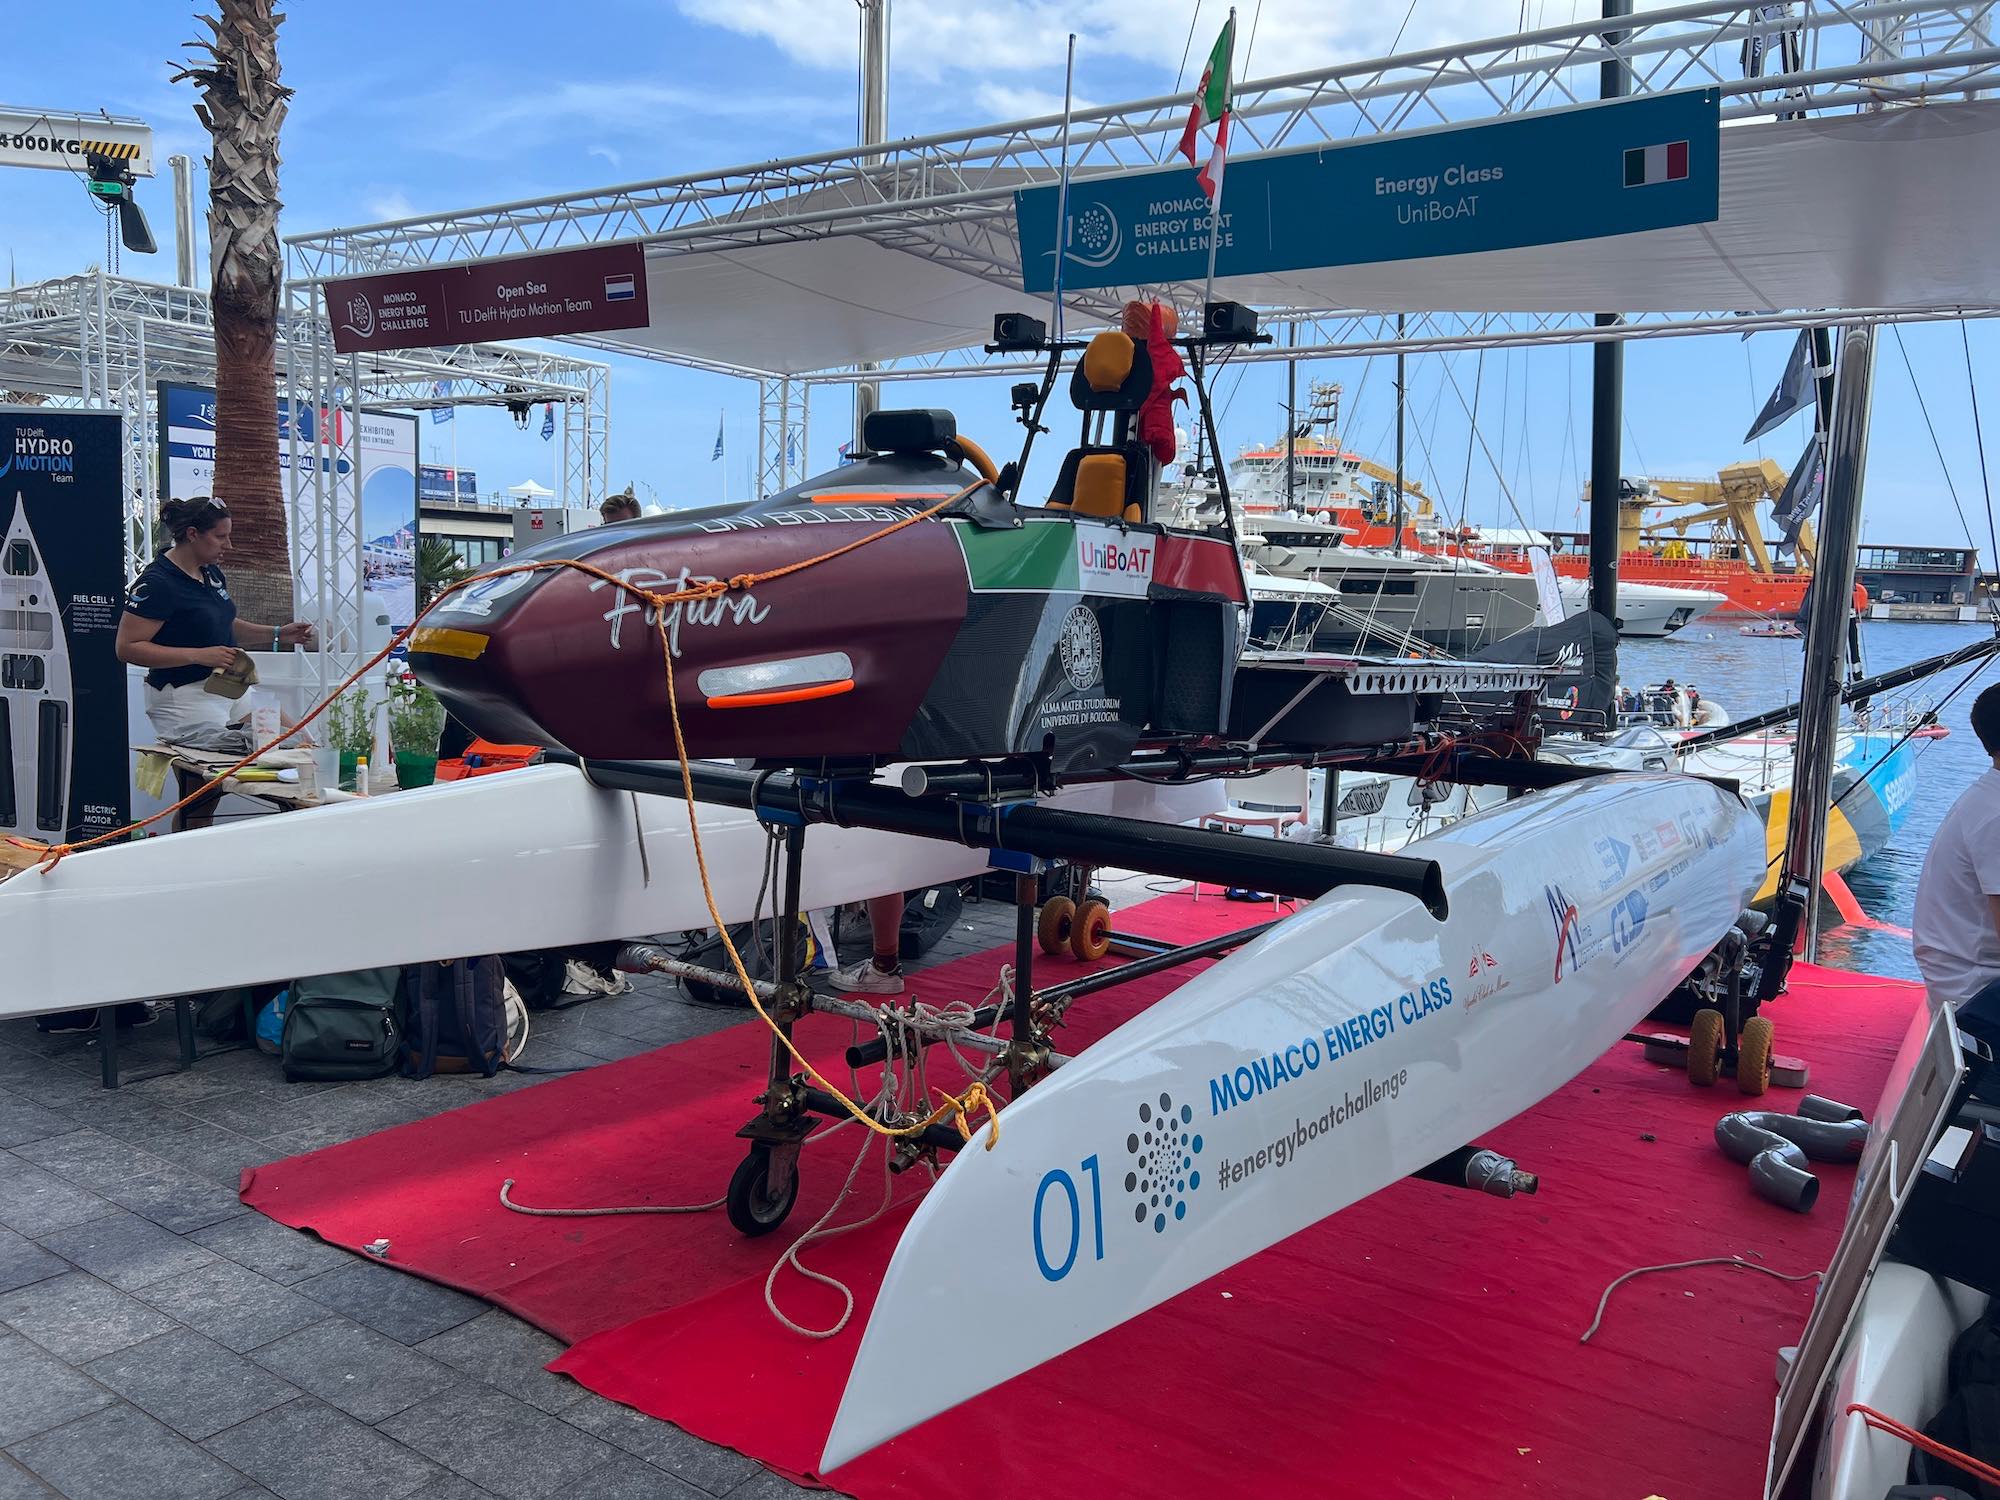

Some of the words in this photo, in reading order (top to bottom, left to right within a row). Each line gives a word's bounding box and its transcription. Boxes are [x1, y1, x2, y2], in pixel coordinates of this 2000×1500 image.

[1375, 175, 1438, 196] Energy
[1443, 164, 1503, 186] Class
[1149, 197, 1214, 216] MONACO
[1397, 195, 1479, 224] UniBoAT
[1135, 219, 1188, 238] ENERGY
[1193, 214, 1233, 232] BOAT
[1136, 233, 1234, 256] CHALLENGE
[383, 292, 417, 304] MONACO
[497, 285, 525, 302] Open
[526, 281, 547, 296] Sea
[379, 307, 405, 318] ENERGY
[406, 304, 427, 316] BOAT
[459, 310, 472, 324] TU
[474, 306, 497, 323] Delft
[500, 304, 526, 323] Hydro
[528, 302, 562, 317] Motion
[564, 298, 592, 313] Team
[381, 318, 430, 331] CHALLENGE
[16, 428, 26, 437] TU
[27, 428, 44, 437] Delft
[360, 425, 395, 436] EXHIBITION
[15, 438, 73, 455] HYDRO
[192, 446, 211, 459] YCM
[15, 455, 73, 472] MOTION
[51, 473, 74, 483] Team
[693, 515, 765, 533] UNI
[763, 506, 936, 525] BOLOGNA
[1081, 541, 1151, 573] UniBoAT
[73, 594, 90, 603] FUEL
[90, 595, 108, 604] CELL
[587, 566, 772, 659] Futura
[1041, 702, 1060, 714] ALMA
[1061, 700, 1082, 711] MATER
[1083, 698, 1120, 710] STUDIORUM
[1081, 712, 1089, 723] DI
[1090, 711, 1119, 722] BOLOGNA
[83, 804, 117, 815] ELECTRIC
[84, 815, 112, 825] MOTOR
[1209, 1037, 1321, 1117] MONACO
[1325, 1004, 1396, 1063] ENERGY
[1398, 976, 1453, 1026] CLASS
[1218, 1068, 1408, 1191] #energyboatchallenge
[1032, 1152, 1104, 1283] 01
